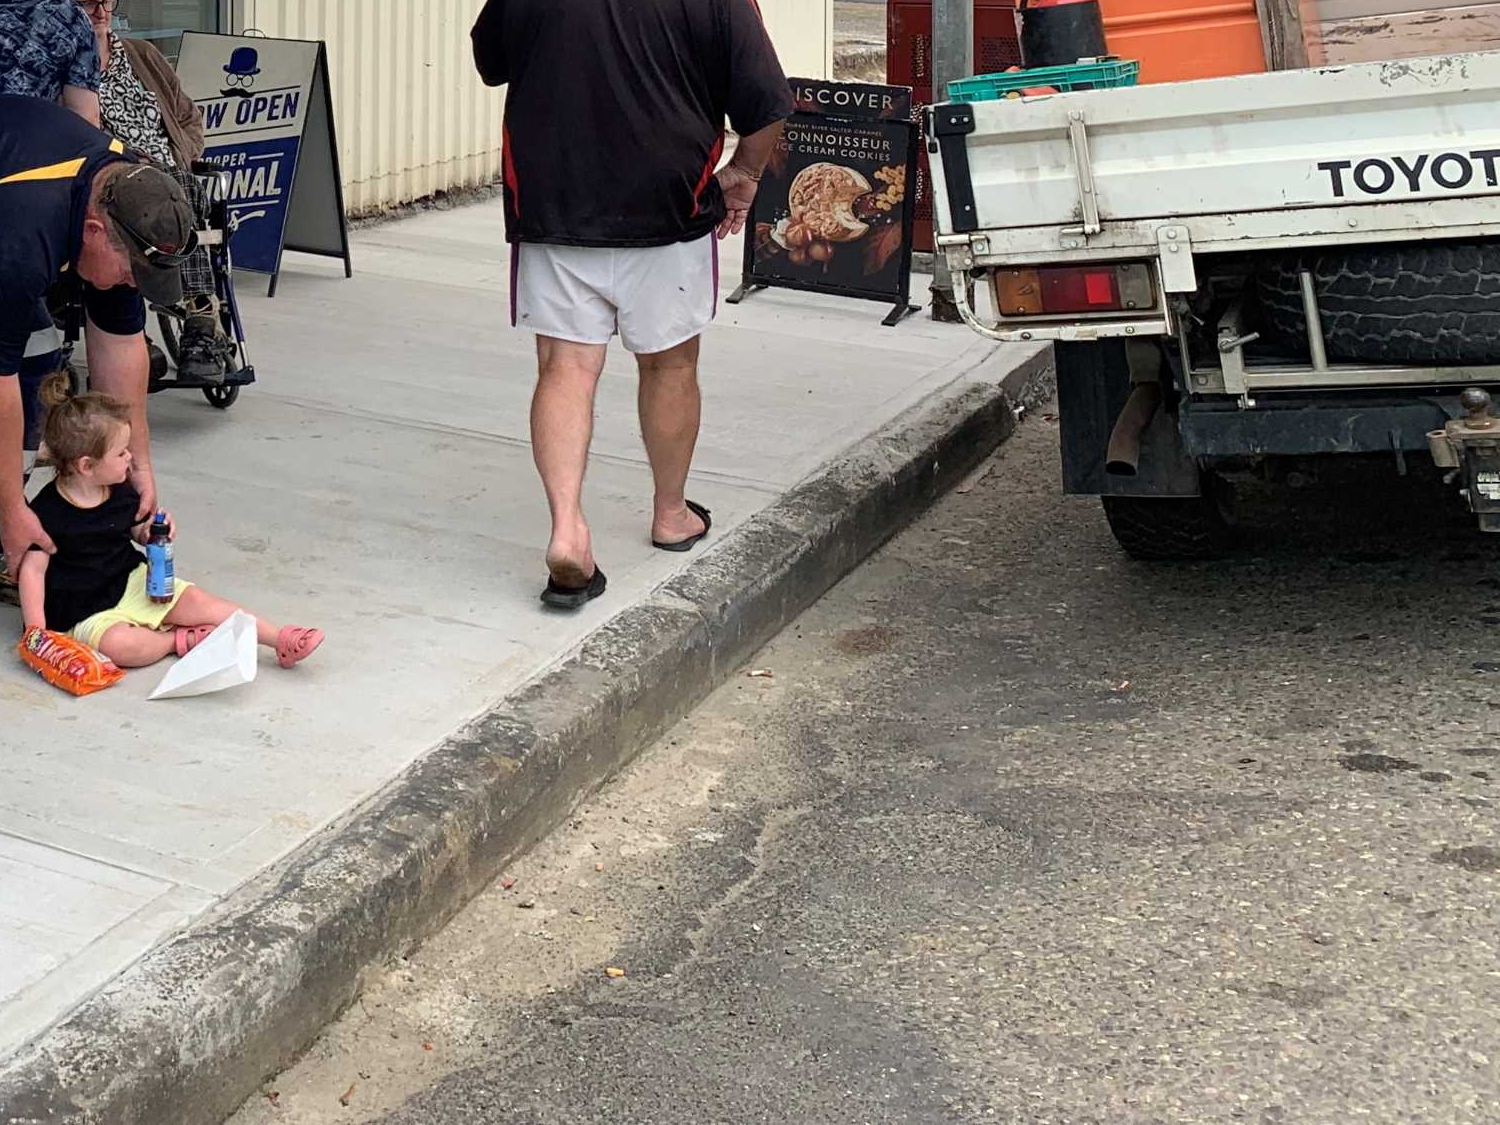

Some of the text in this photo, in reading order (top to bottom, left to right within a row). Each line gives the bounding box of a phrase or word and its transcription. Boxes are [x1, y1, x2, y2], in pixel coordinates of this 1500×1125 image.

[795, 86, 893, 110] ISCOVER
[197, 91, 300, 130] OW OPEN
[776, 142, 891, 162] ICE CREAM COOKIES
[781, 130, 891, 151] ONNOISSEUR
[1317, 148, 1500, 197] TOYOT
